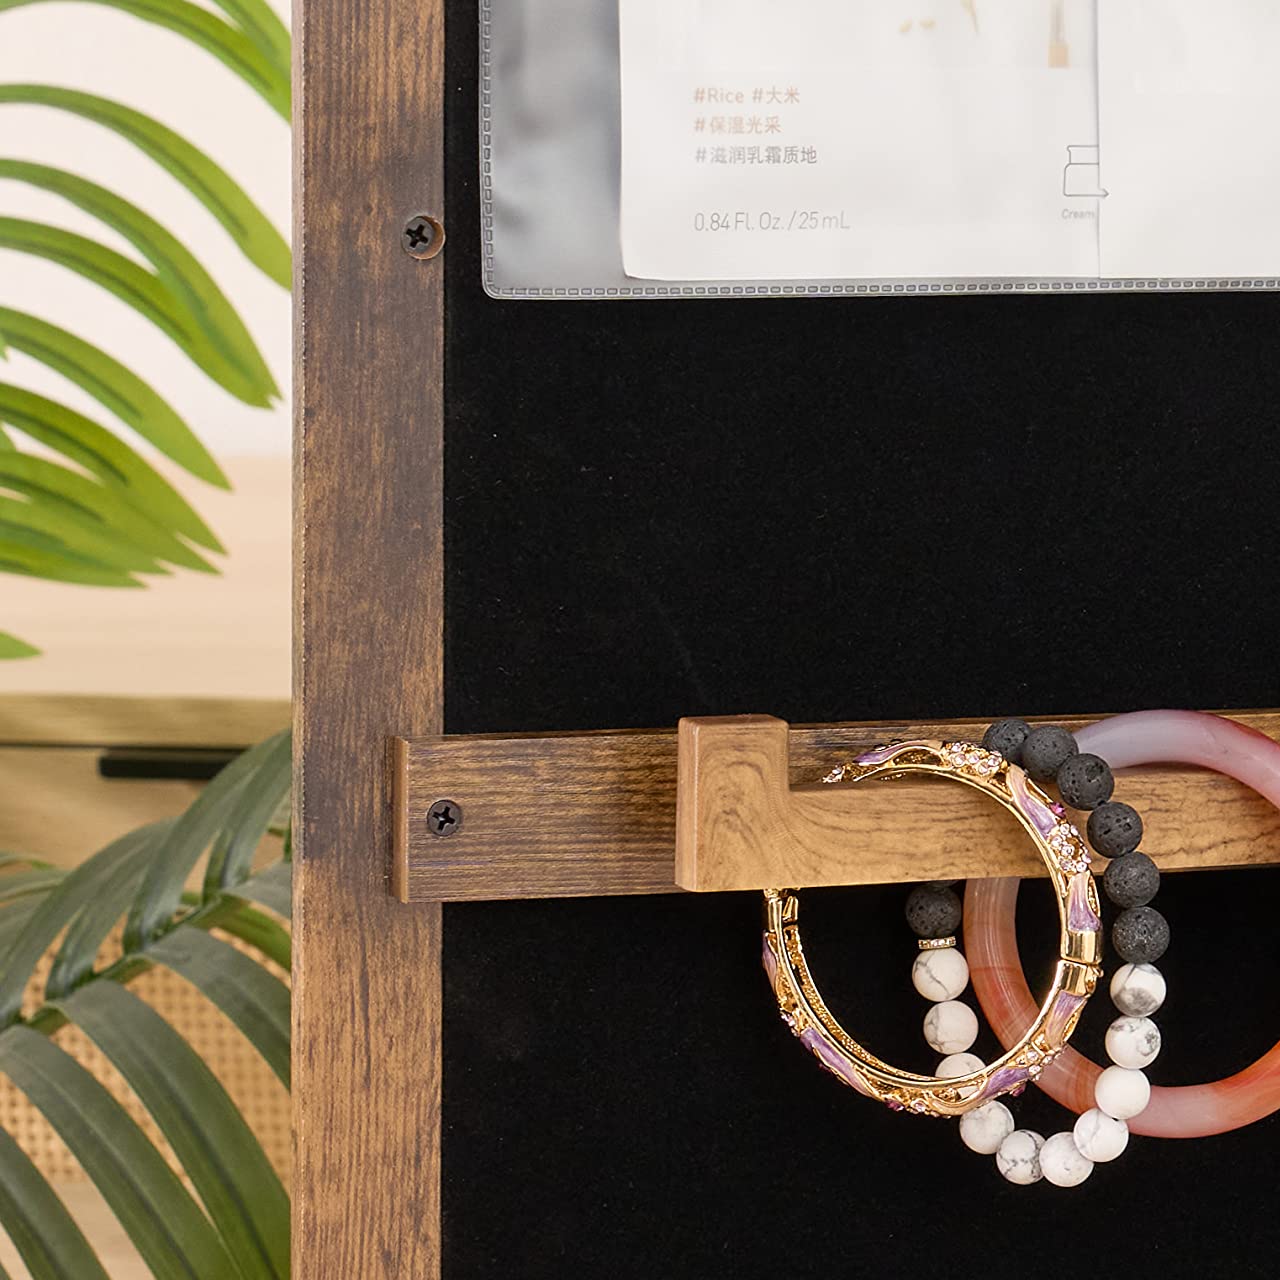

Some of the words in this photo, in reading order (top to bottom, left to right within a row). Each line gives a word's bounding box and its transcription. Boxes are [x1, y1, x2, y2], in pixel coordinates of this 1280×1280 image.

[694, 87, 745, 103] #Rice
[752, 85, 801, 104] #大米
[694, 212, 730, 231] 0.84
[1061, 208, 1095, 220] Cream
